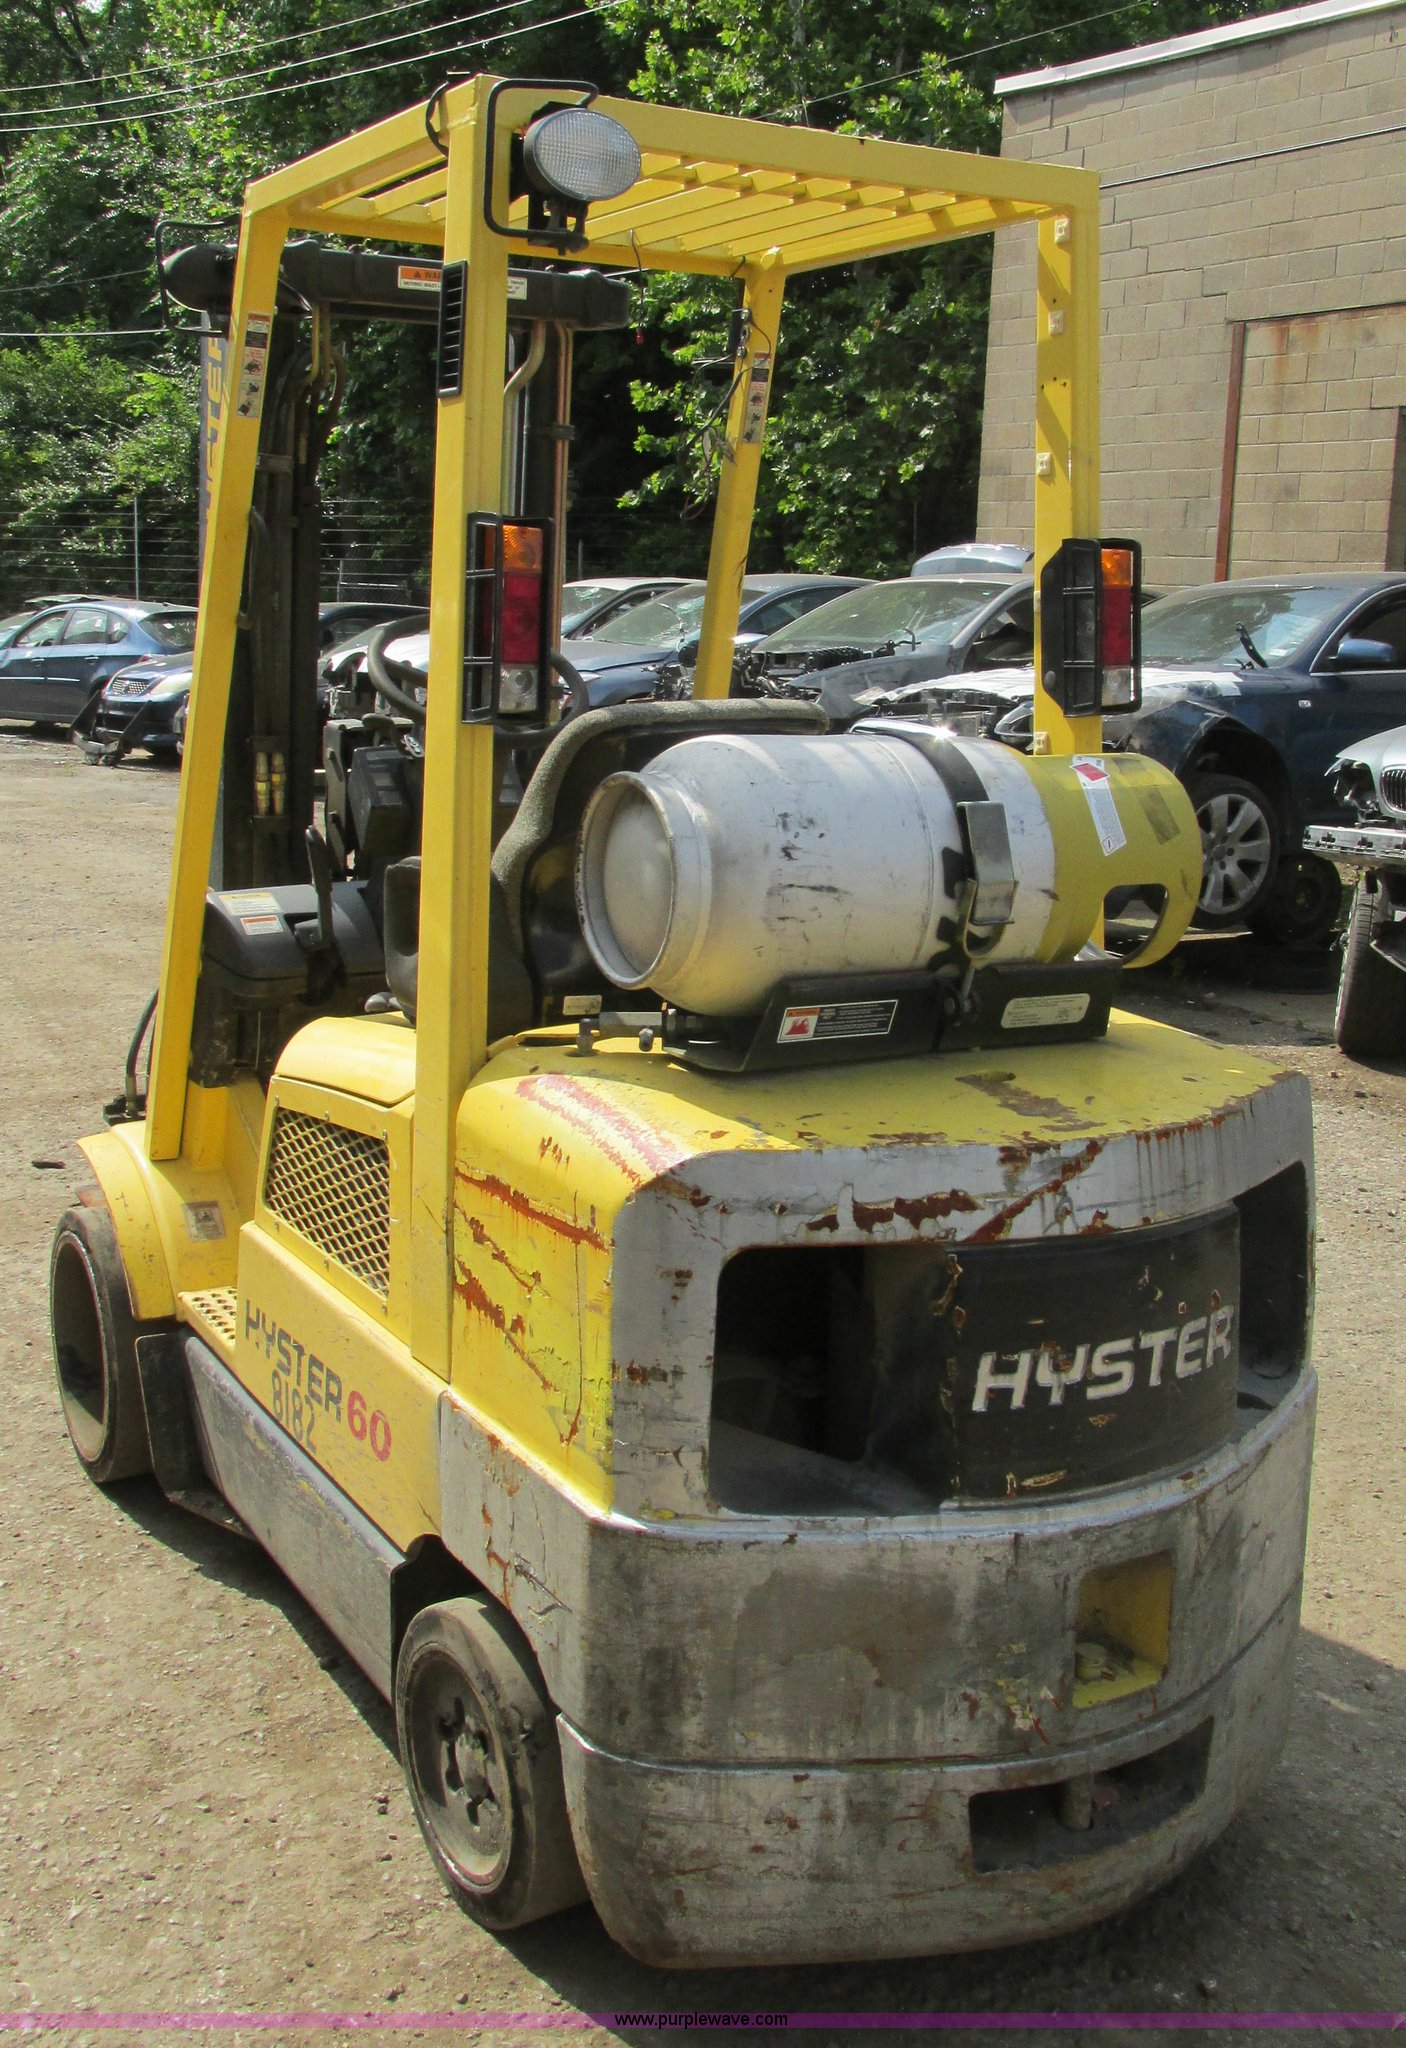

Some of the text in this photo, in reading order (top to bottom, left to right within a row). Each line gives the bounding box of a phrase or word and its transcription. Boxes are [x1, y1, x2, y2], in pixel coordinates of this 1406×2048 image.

[245, 1298, 392, 1462] HYSTER 60
[272, 1369, 317, 1455] 8182
[972, 1304, 1235, 1413] HYSTER
